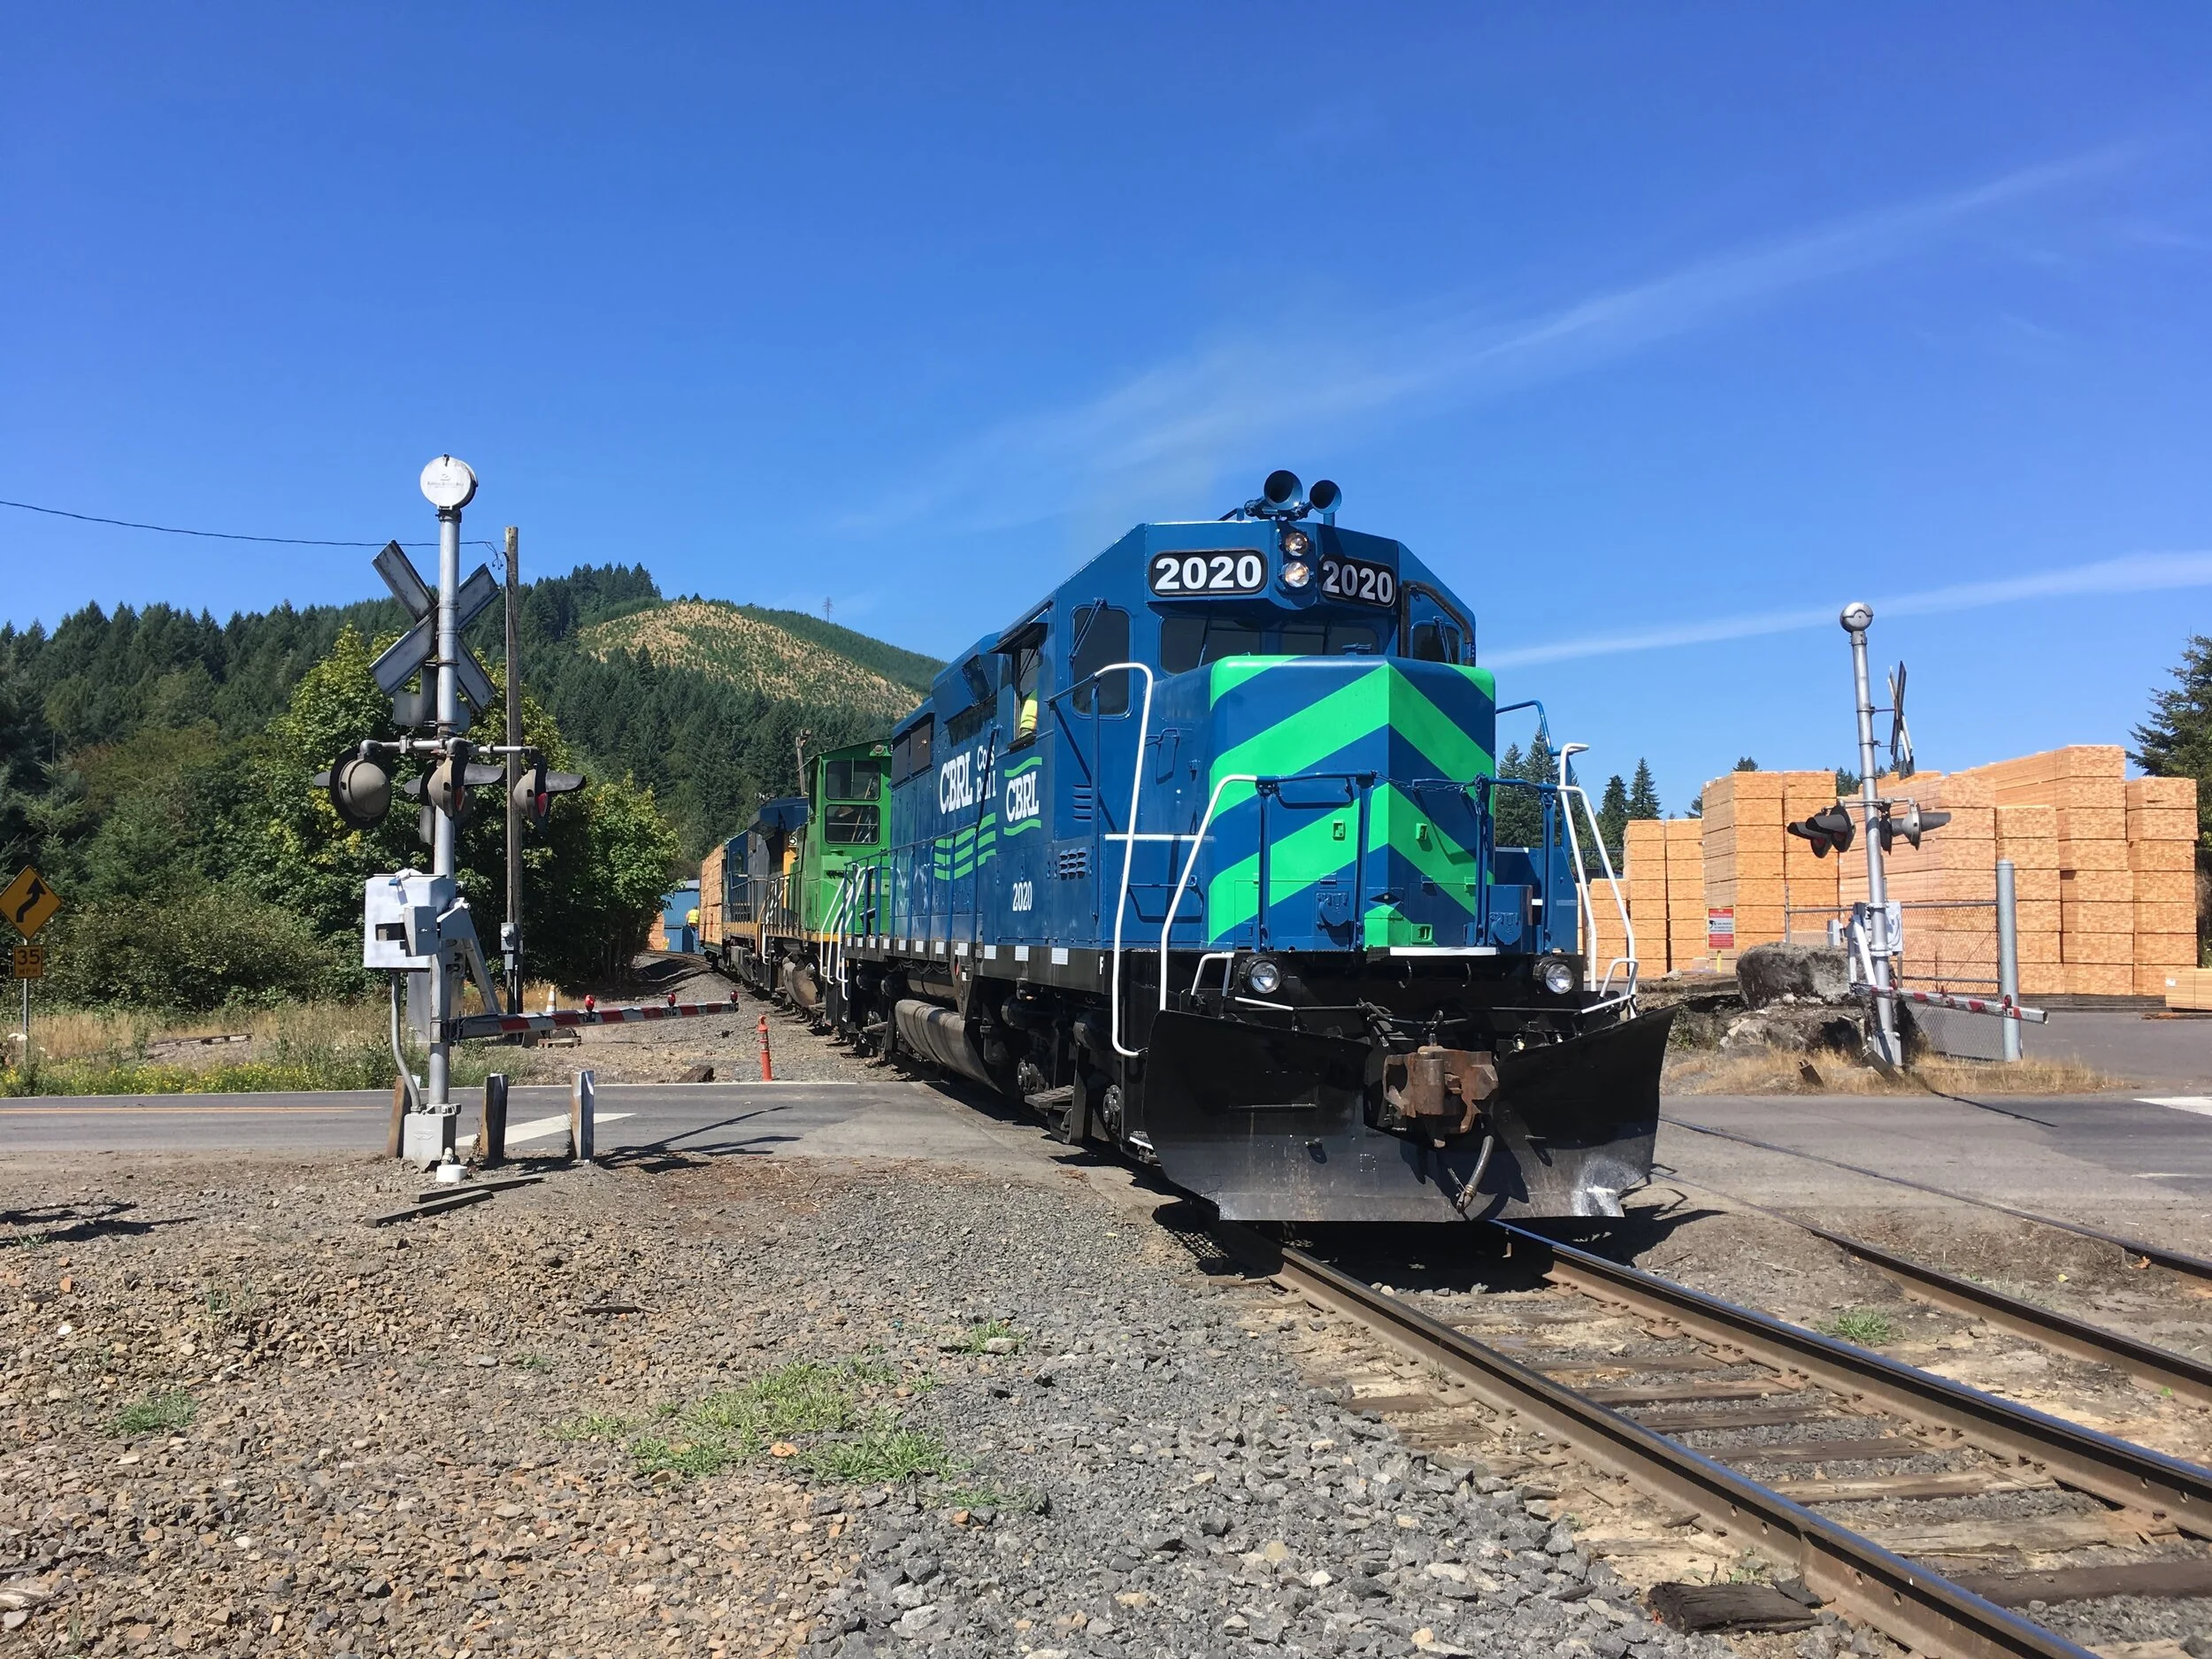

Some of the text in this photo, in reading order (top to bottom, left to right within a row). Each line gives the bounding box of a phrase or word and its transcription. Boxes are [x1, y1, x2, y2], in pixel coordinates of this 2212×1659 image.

[1155, 555, 1262, 590] 2020
[1322, 561, 1394, 603] 2020
[977, 745, 995, 772] Cos
[940, 751, 972, 814] CBRL
[1006, 771, 1040, 822] CBRL
[1012, 881, 1032, 911] 2020
[18, 949, 41, 964] 35
[1100, 956, 1103, 974] F
